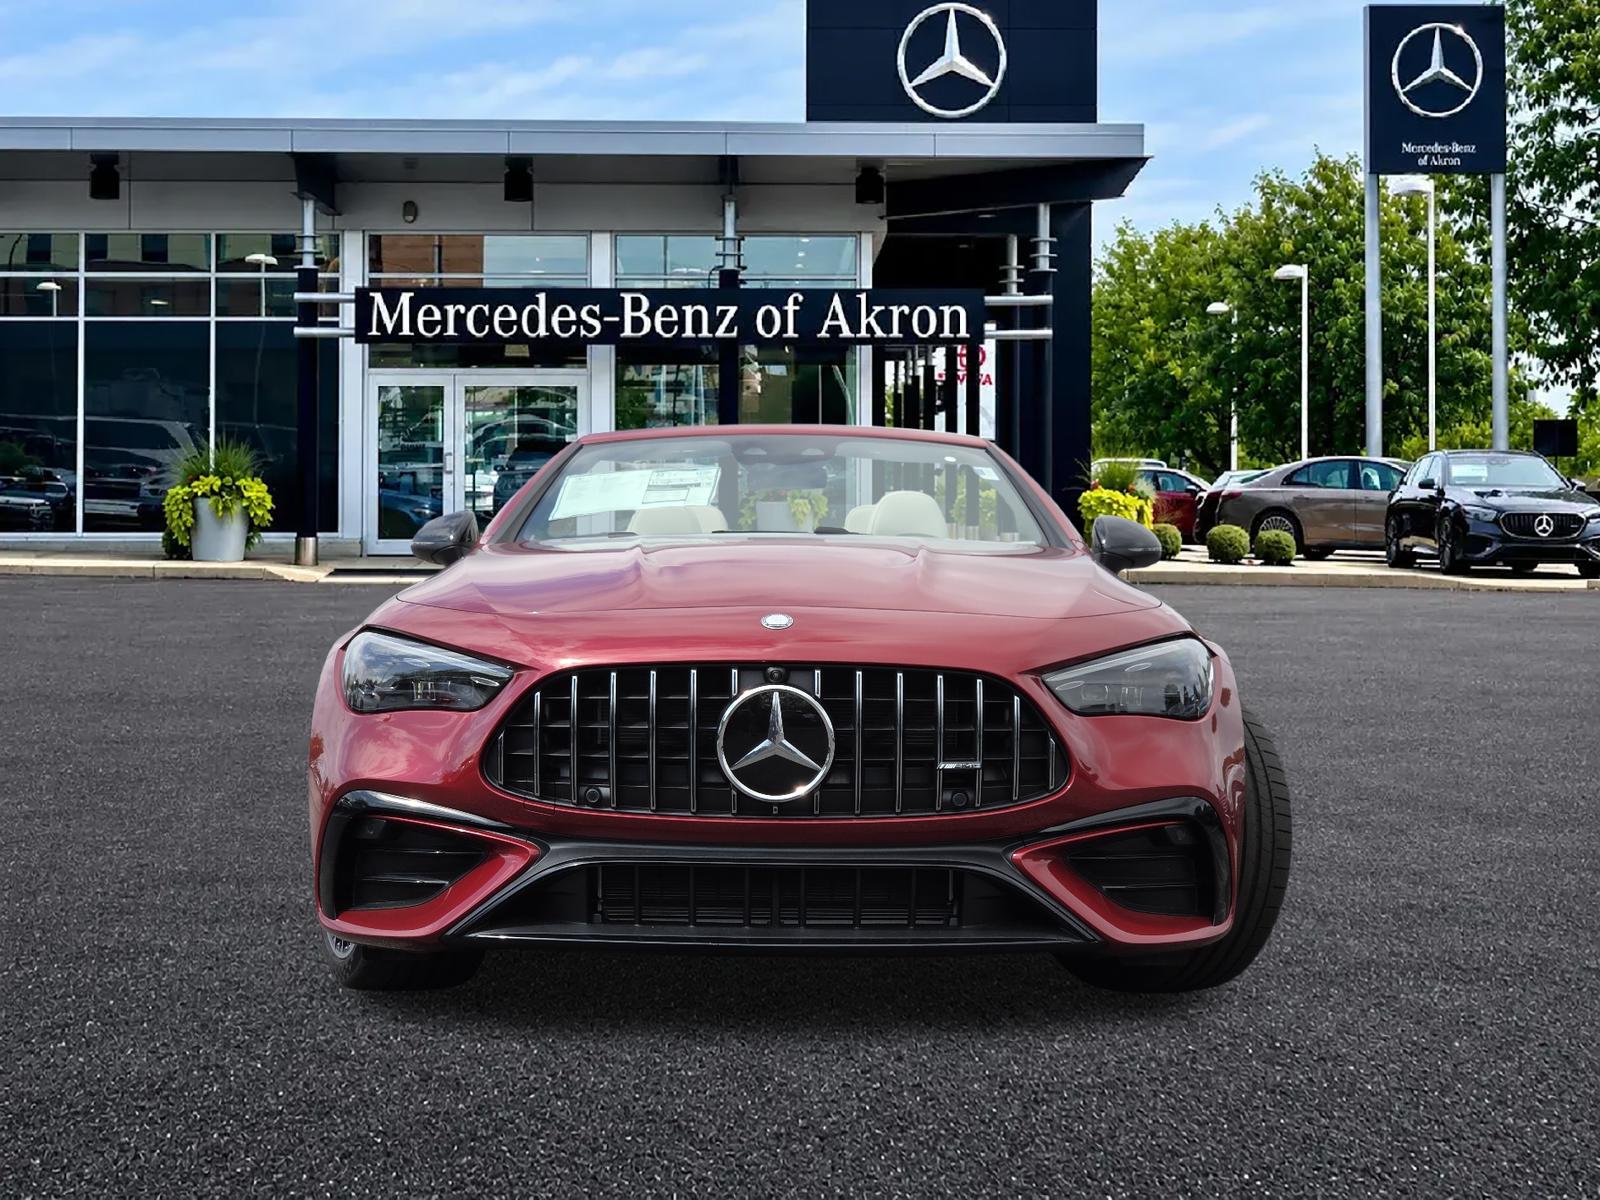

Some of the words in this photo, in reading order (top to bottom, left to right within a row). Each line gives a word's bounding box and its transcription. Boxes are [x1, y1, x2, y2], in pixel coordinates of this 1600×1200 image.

[1401, 141, 1477, 154] Mercedes-Benz
[1417, 154, 1429, 166] of
[1429, 154, 1461, 166] Akron
[367, 291, 738, 338] Mercedes-Benz
[755, 291, 804, 339] of
[816, 291, 970, 339] Akron
